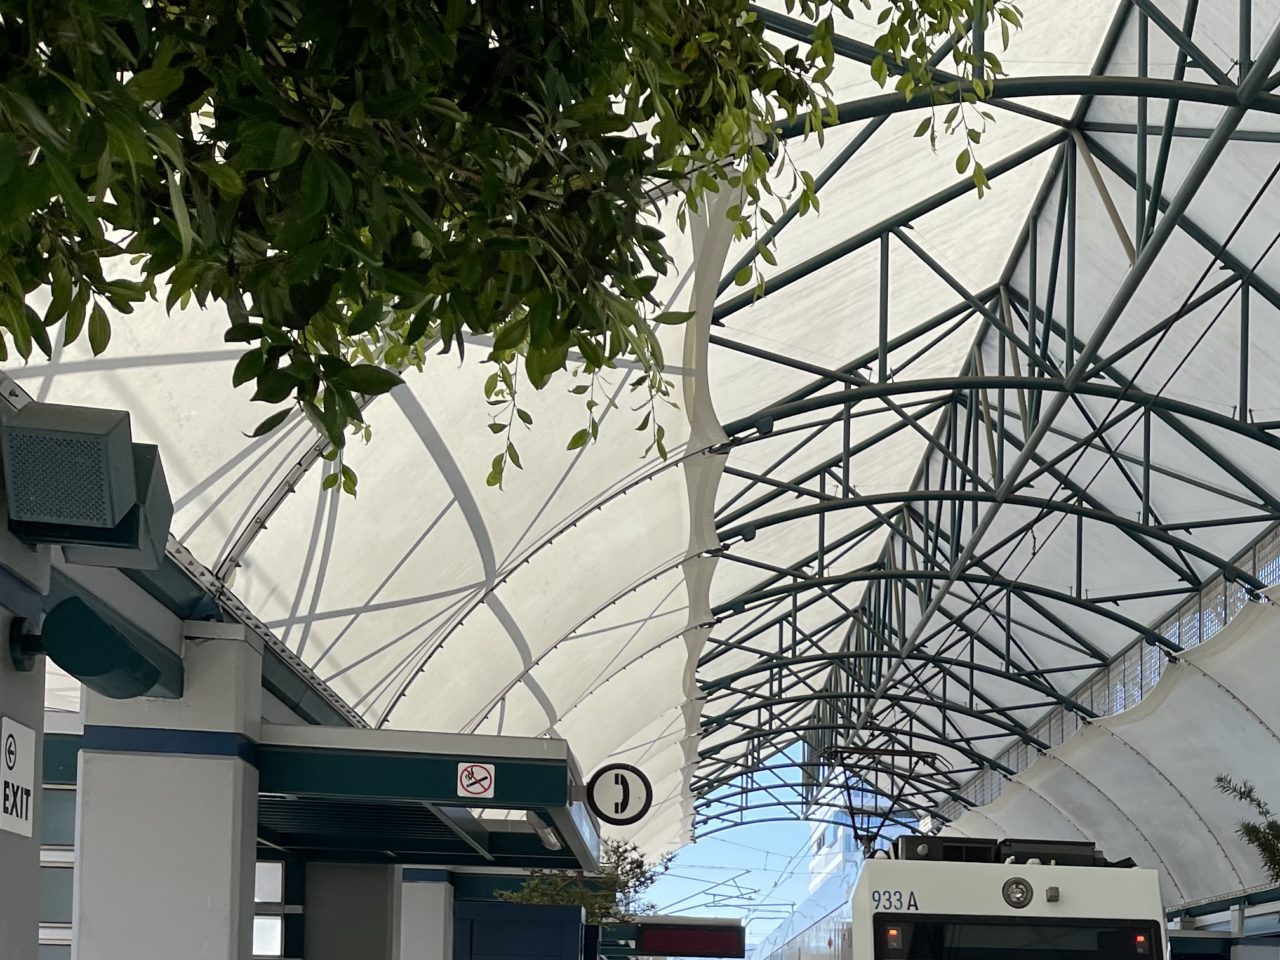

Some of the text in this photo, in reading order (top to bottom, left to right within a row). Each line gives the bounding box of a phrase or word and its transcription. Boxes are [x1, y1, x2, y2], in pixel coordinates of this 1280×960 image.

[3, 780, 31, 821] EXIT
[872, 890, 919, 911] 933 A
